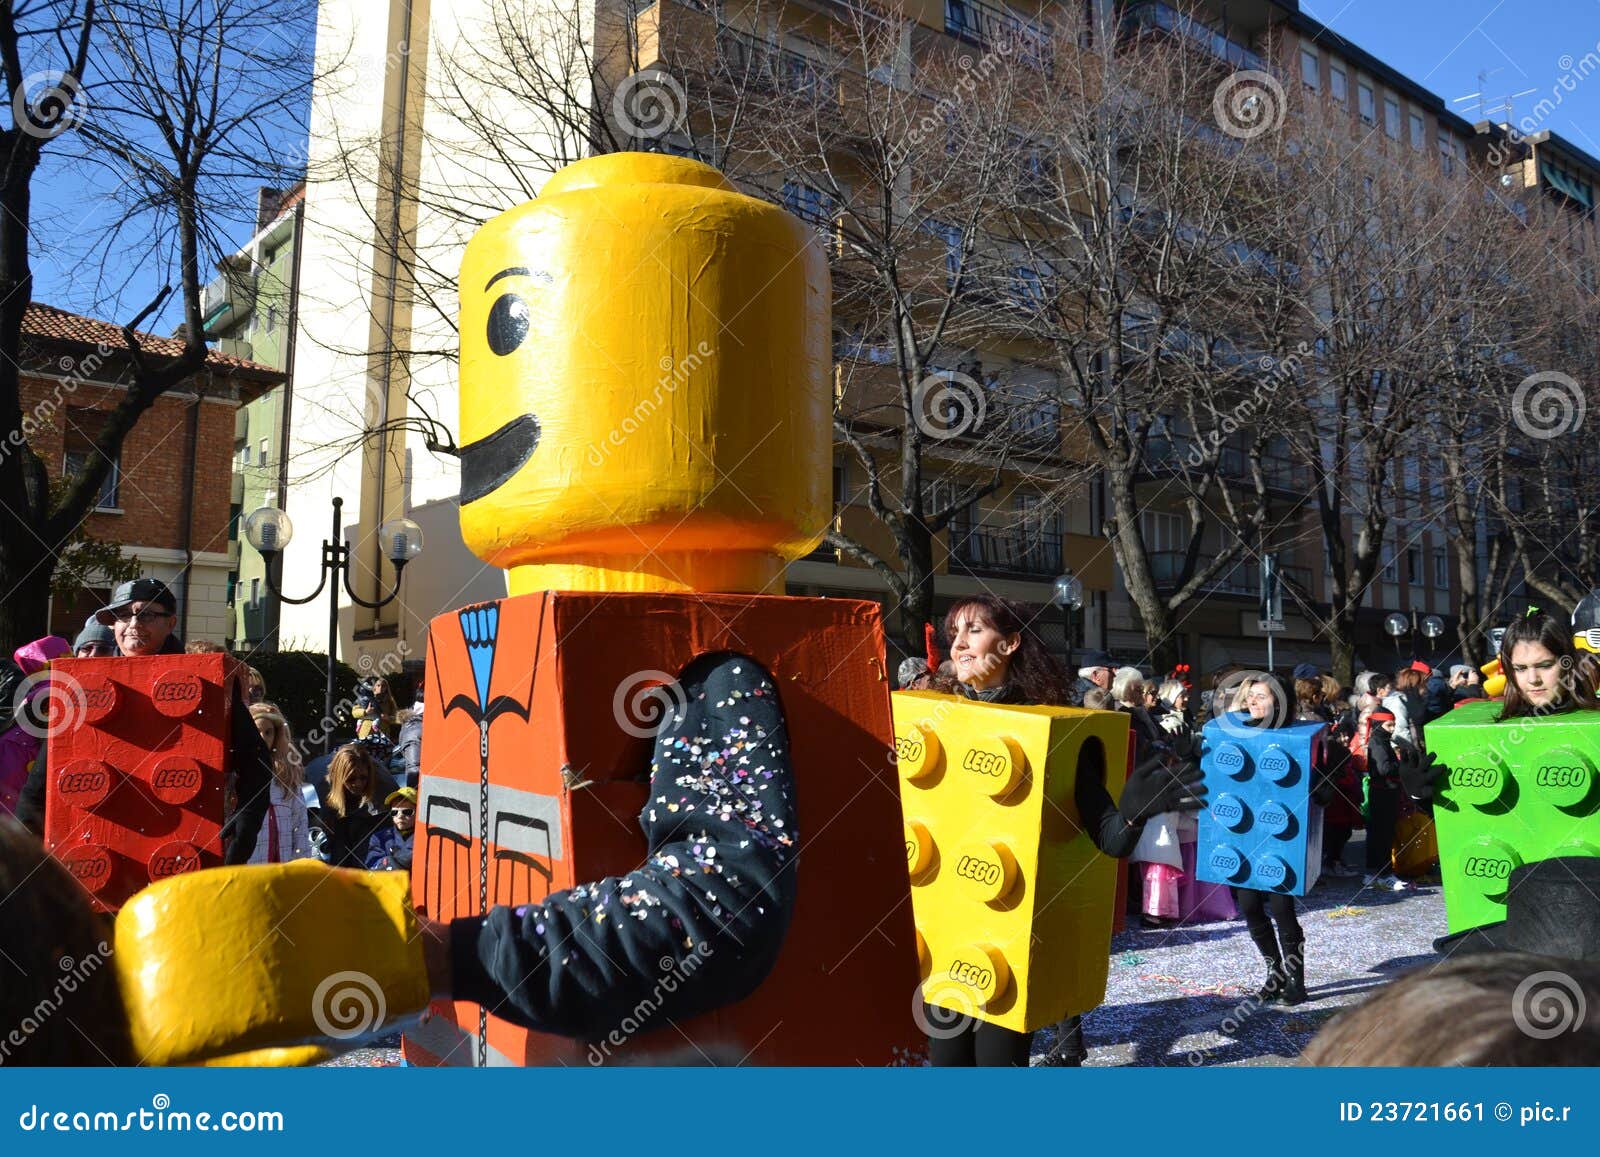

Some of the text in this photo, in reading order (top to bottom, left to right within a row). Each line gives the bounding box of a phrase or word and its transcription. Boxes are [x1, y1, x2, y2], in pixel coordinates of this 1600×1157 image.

[153, 682, 198, 701] LEGO
[894, 737, 1007, 777] EGO LEGO
[1216, 752, 1287, 771] LEGO LEGO
[61, 769, 199, 794] LEGO LEGO
[1452, 766, 1586, 788] LEGO LEGO
[1213, 803, 1285, 825] LEGO LEGO
[67, 856, 198, 878] EGO LEGO
[956, 855, 1001, 886] LEGO
[1211, 854, 1282, 878] LEGO LEGO
[1465, 857, 1512, 879] LEGO
[949, 960, 992, 991] LEGO
